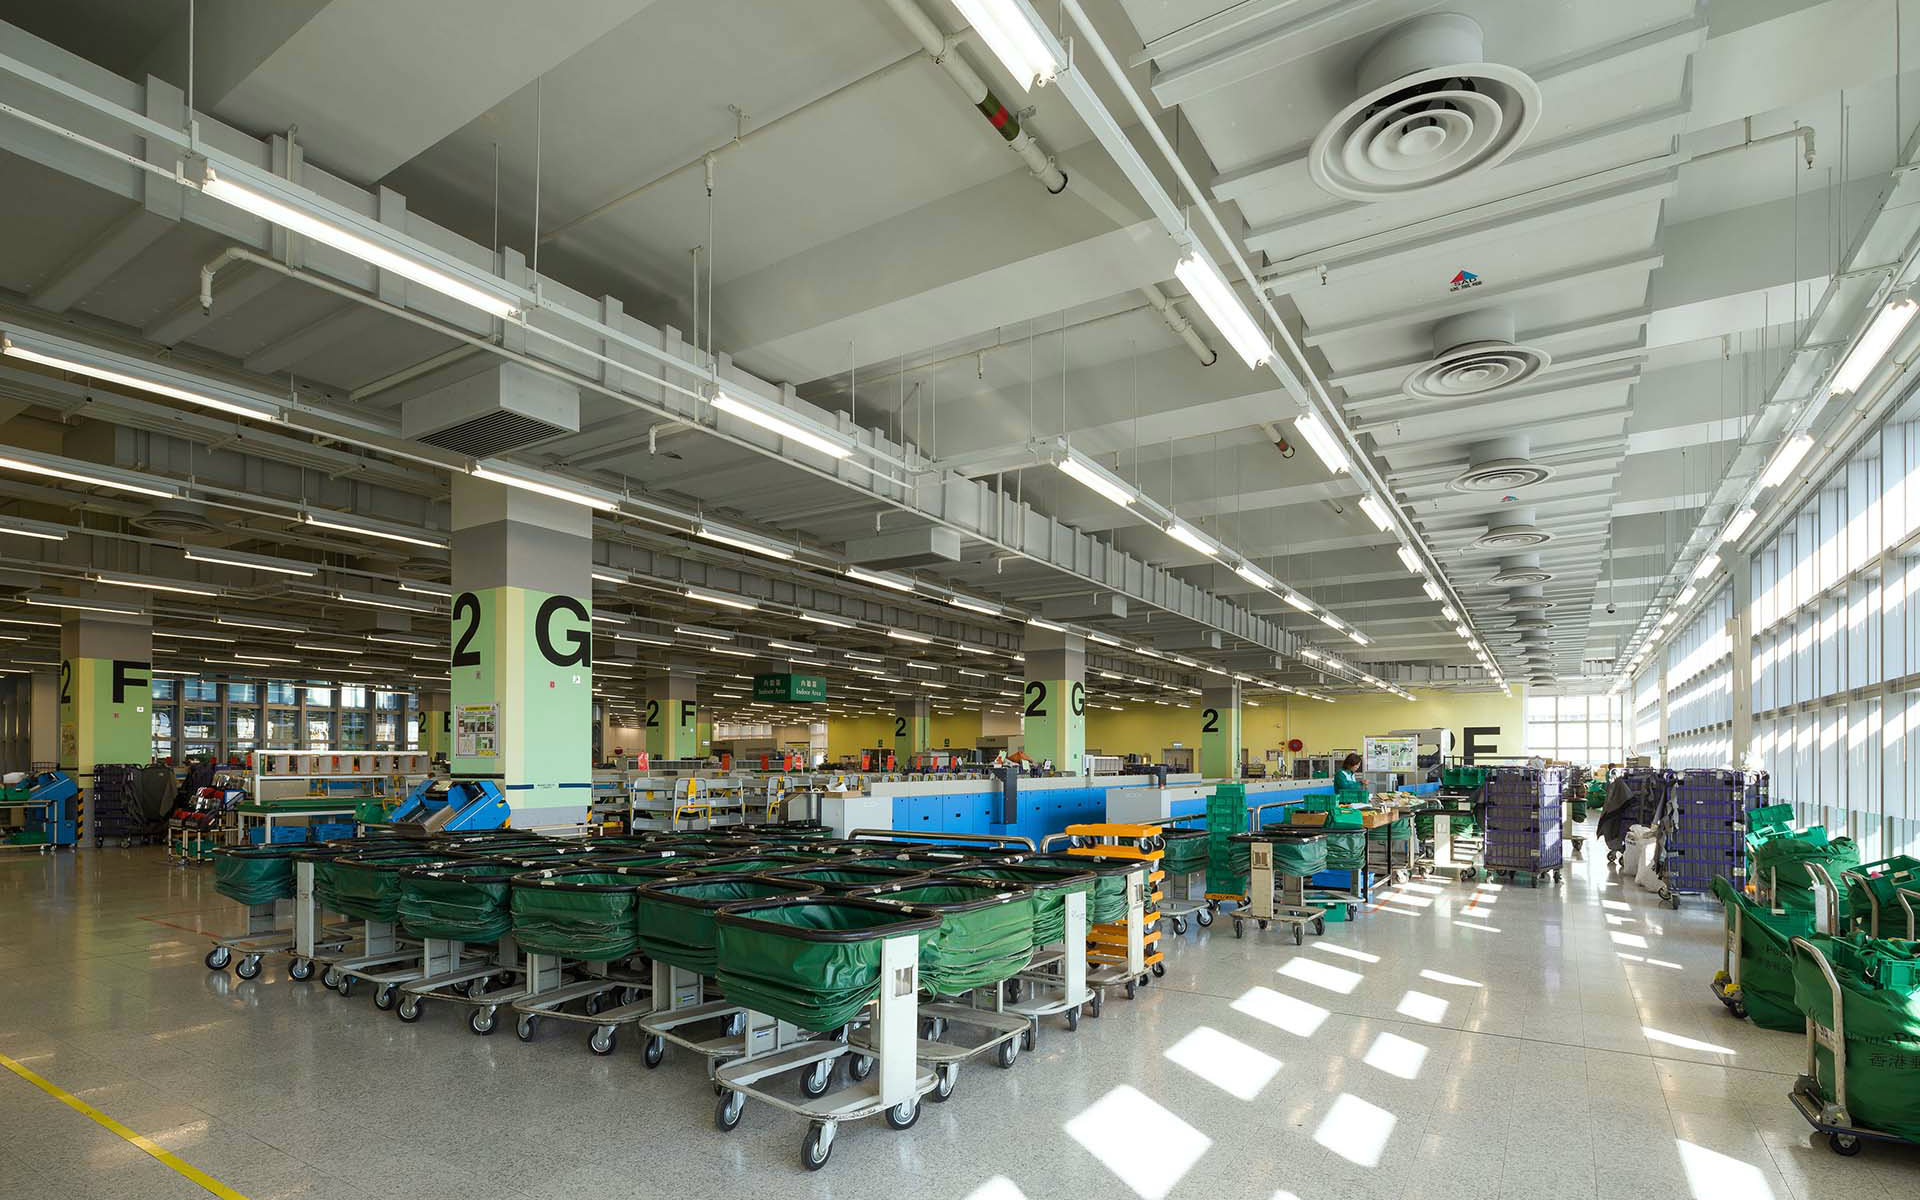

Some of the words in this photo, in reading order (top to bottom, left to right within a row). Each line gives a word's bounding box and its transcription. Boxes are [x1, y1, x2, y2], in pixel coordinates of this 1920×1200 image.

[452, 592, 480, 667] 2
[535, 595, 591, 668] G
[61, 660, 71, 704] 2
[112, 660, 151, 704] F
[1025, 681, 1047, 717] 2
[1071, 681, 1085, 716] G
[419, 712, 426, 733] 2
[646, 700, 659, 727] 2
[681, 700, 696, 727] F
[895, 717, 906, 737] 2
[1202, 708, 1219, 733] 2
